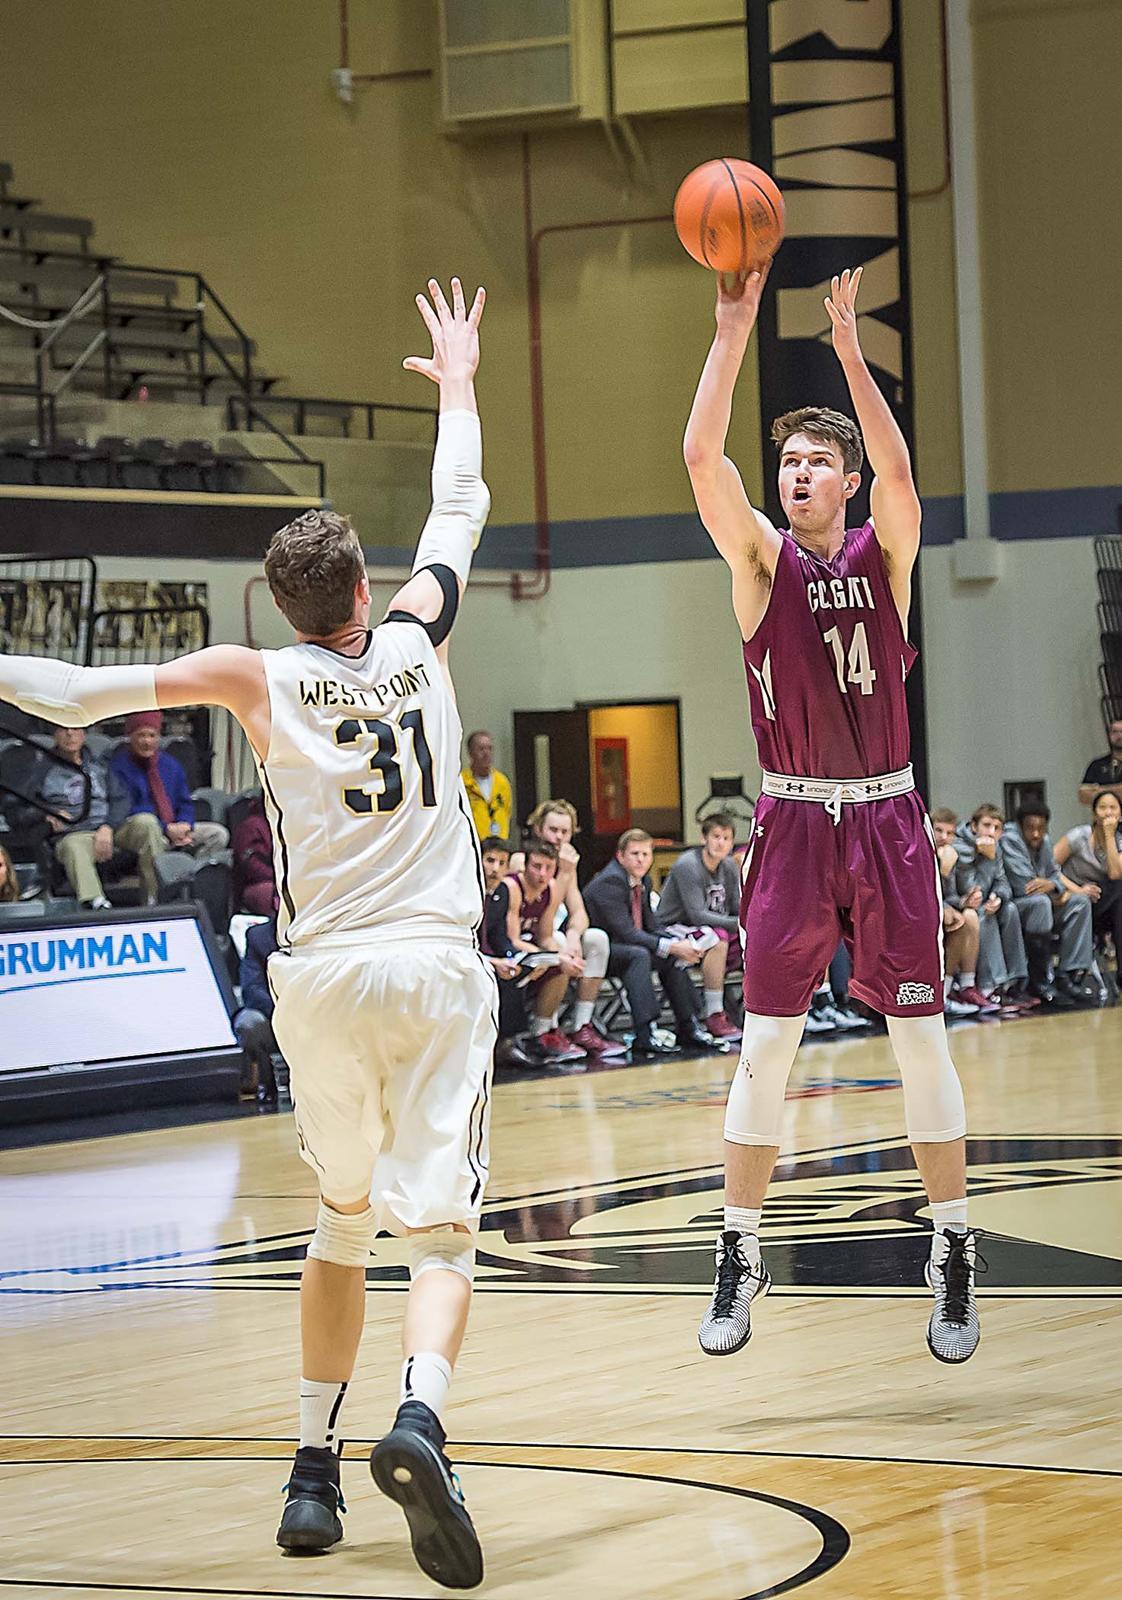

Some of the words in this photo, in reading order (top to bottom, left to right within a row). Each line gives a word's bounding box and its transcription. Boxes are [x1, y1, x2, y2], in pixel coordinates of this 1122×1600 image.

[823, 621, 876, 695] 14
[300, 680, 369, 706] WEST
[334, 707, 438, 816] 31
[0, 931, 168, 976] RUMMAN
[896, 988, 935, 1001] PATRIOT
[897, 996, 935, 1006] LEAGUE
